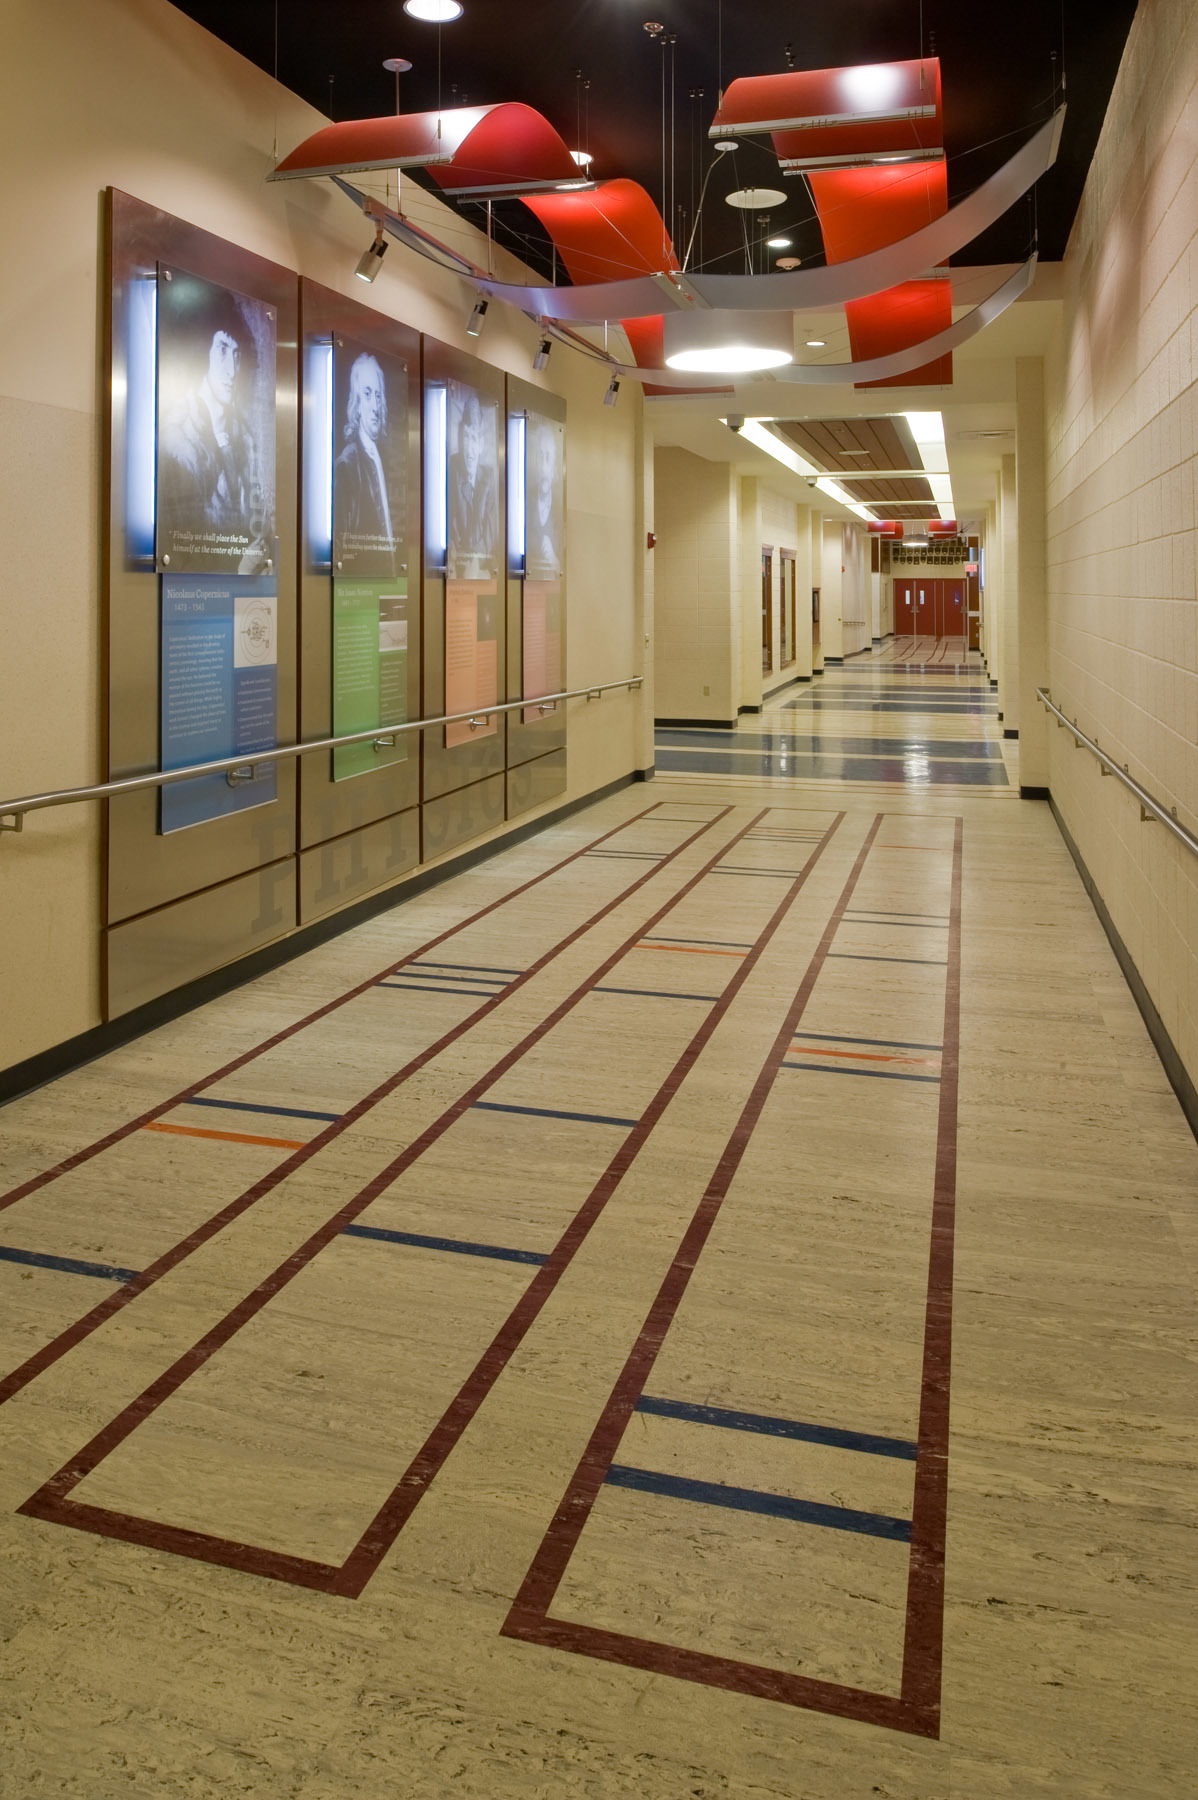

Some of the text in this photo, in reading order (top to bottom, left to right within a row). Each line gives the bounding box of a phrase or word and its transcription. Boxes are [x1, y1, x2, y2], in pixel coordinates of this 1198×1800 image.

[216, 533, 230, 543] place
[230, 534, 239, 543] the
[239, 535, 249, 544] Sun
[201, 544, 210, 553] the
[210, 547, 228, 555] center
[233, 546, 242, 555] the
[167, 588, 230, 600] Nicolaus Copernicus
